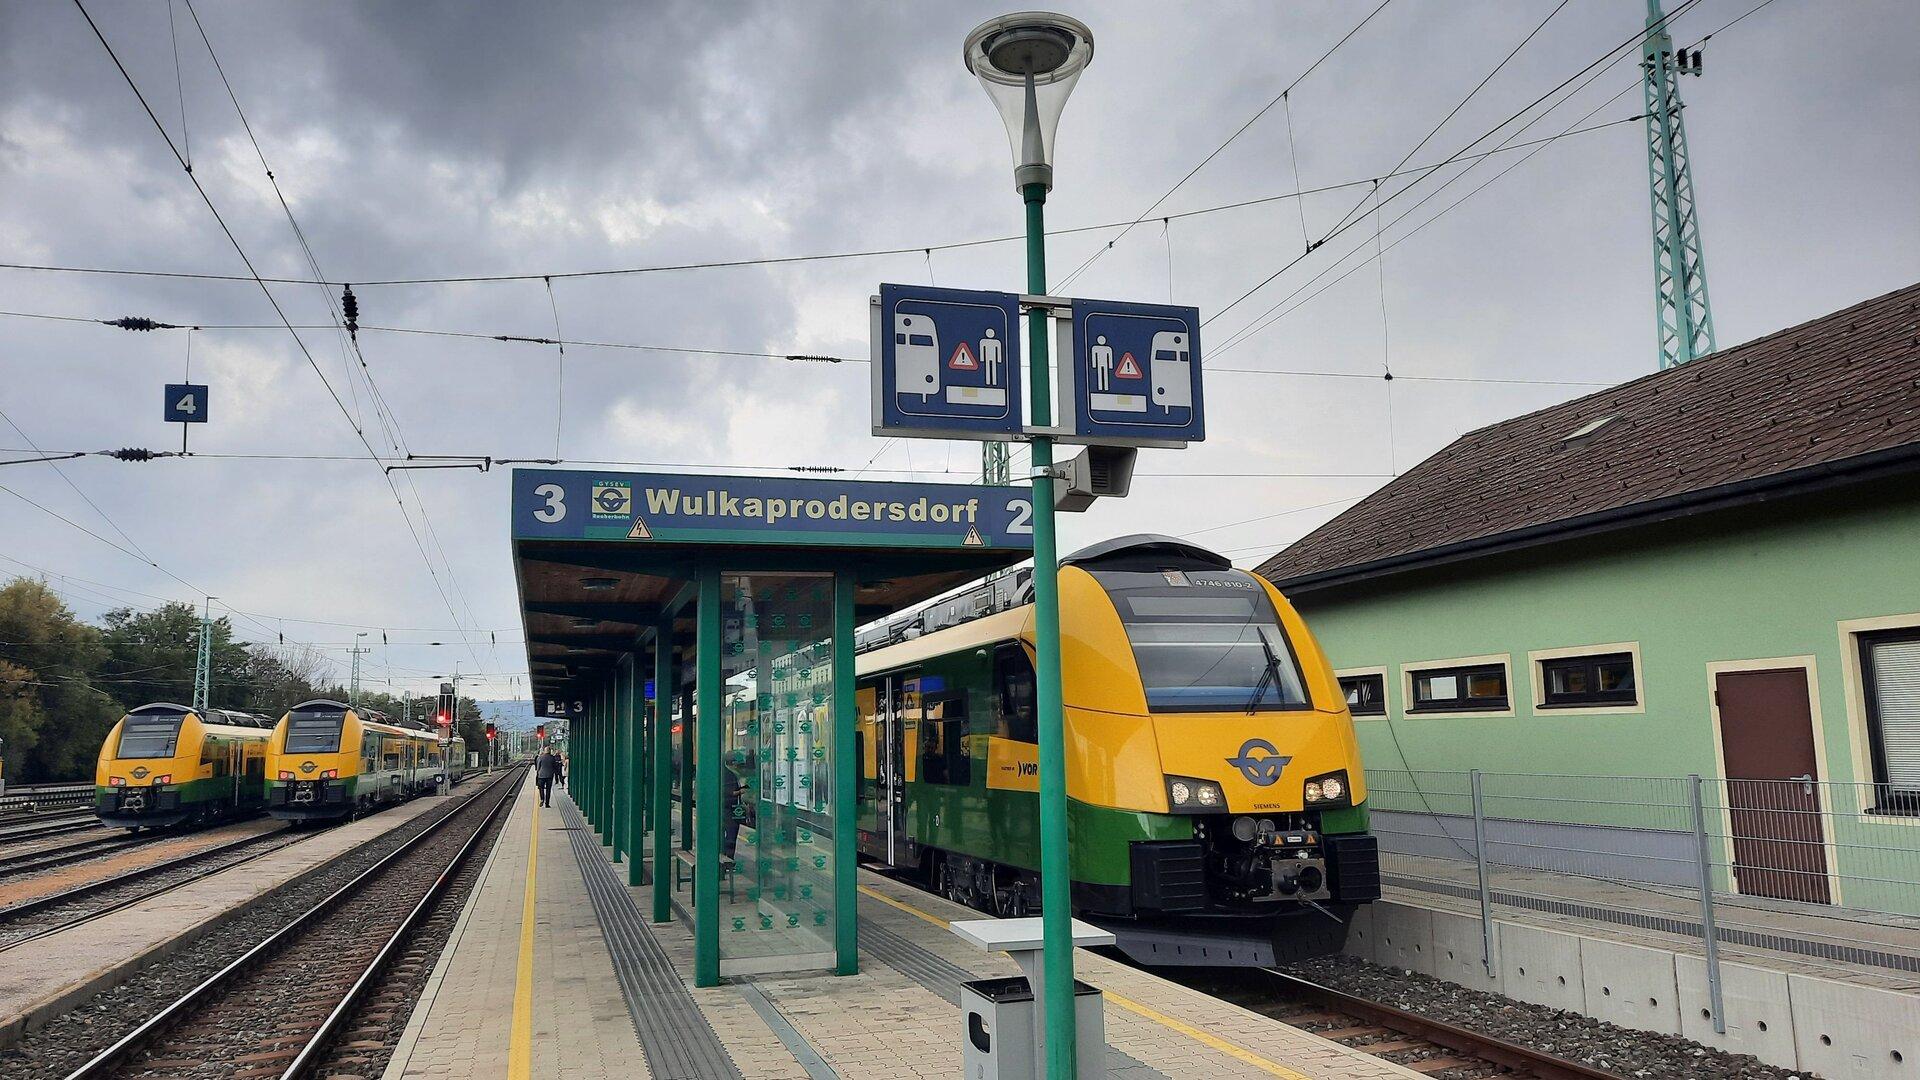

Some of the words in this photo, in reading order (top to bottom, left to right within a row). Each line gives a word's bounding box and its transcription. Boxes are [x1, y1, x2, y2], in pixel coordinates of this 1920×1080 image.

[176, 393, 197, 415] 4
[533, 484, 567, 523] 3
[645, 488, 979, 524] Wulkaprodersdorf
[1005, 499, 1033, 534] 2
[573, 700, 584, 713] 3
